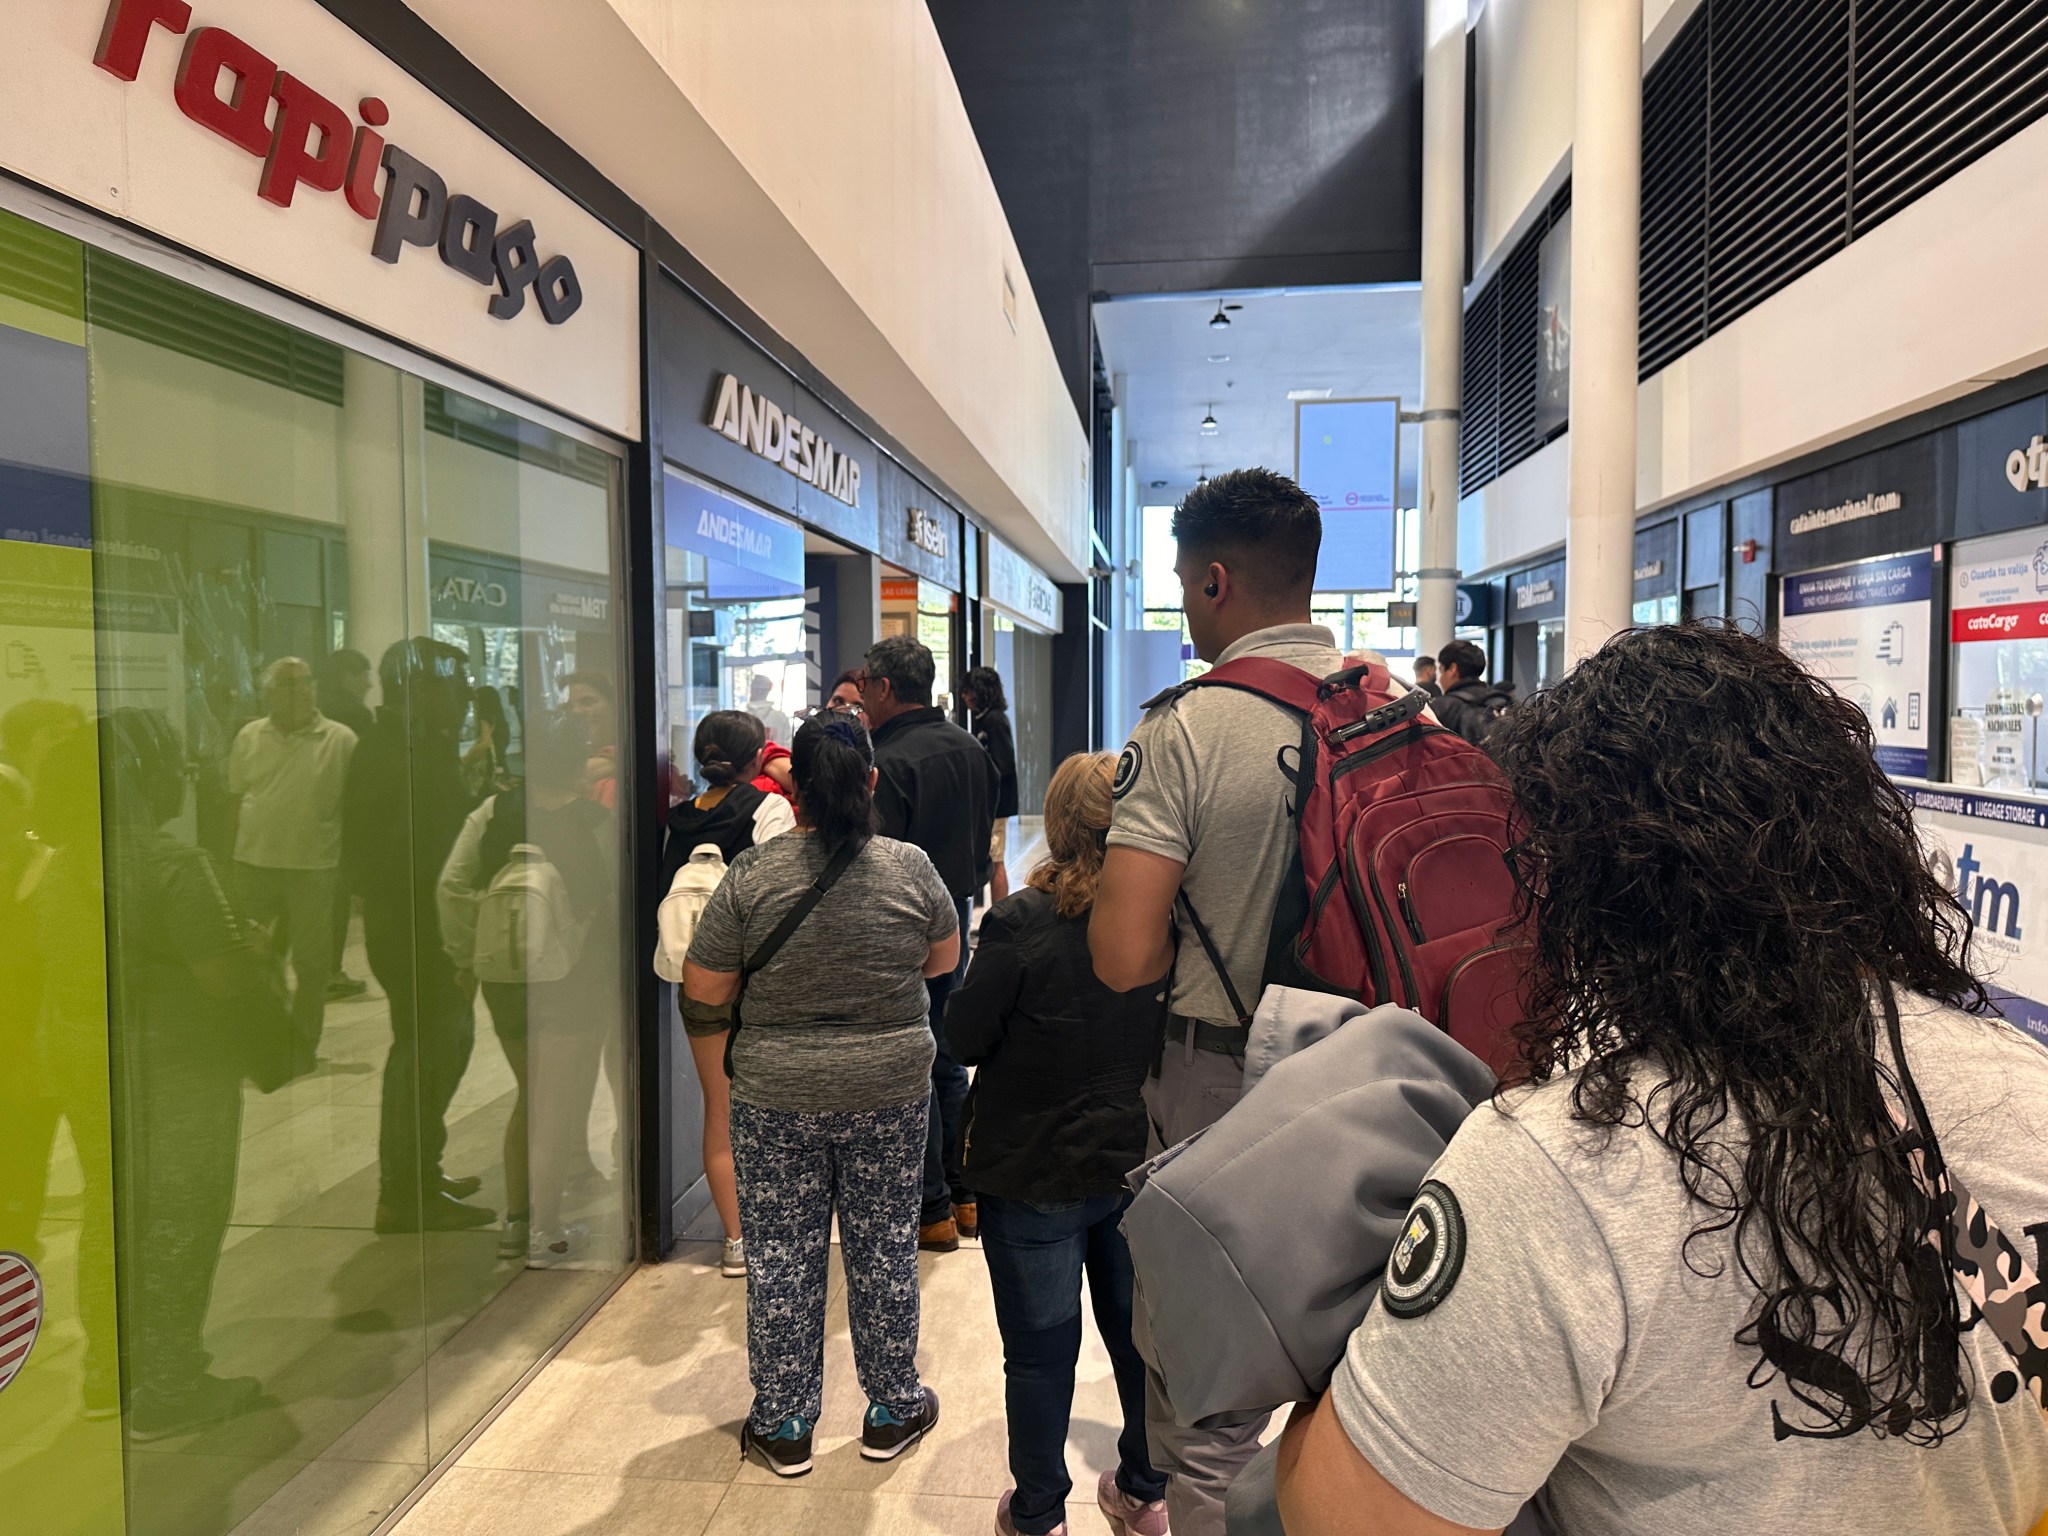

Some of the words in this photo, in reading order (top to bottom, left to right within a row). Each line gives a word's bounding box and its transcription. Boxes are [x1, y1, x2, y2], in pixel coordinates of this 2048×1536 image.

[93, 0, 582, 324] rapipago
[708, 373, 860, 508] ANDESMAR
[2005, 434, 2048, 492] ot
[1790, 491, 1901, 534] catainternacional.com
[697, 510, 772, 559] ANDESMAR
[1816, 580, 1824, 592] TU
[1824, 576, 1851, 591] EQUIPAJE
[1857, 573, 1875, 586] VIAJA
[1875, 570, 1887, 582] SIN
[1888, 566, 1912, 580] CARGA
[1970, 567, 1996, 581] Guarda
[1998, 566, 2006, 576] tu
[2007, 563, 2028, 576] valija
[1516, 583, 1533, 609] TBM
[1816, 594, 1829, 606] YOUR
[1829, 591, 1854, 604] LUGGAGE
[1854, 589, 1866, 600] AND
[1867, 587, 1888, 598] TRAVEL
[1888, 583, 1906, 596] LIGHT
[1967, 613, 2019, 632] cataCargo
[1987, 719, 2022, 732] NACIONALES
[1915, 792, 1964, 815] GUARDAEQUIPAJE
[1975, 800, 2005, 820] LUGGAGE
[2005, 805, 2036, 825] STORAGE
[2027, 1015, 2048, 1036] info
